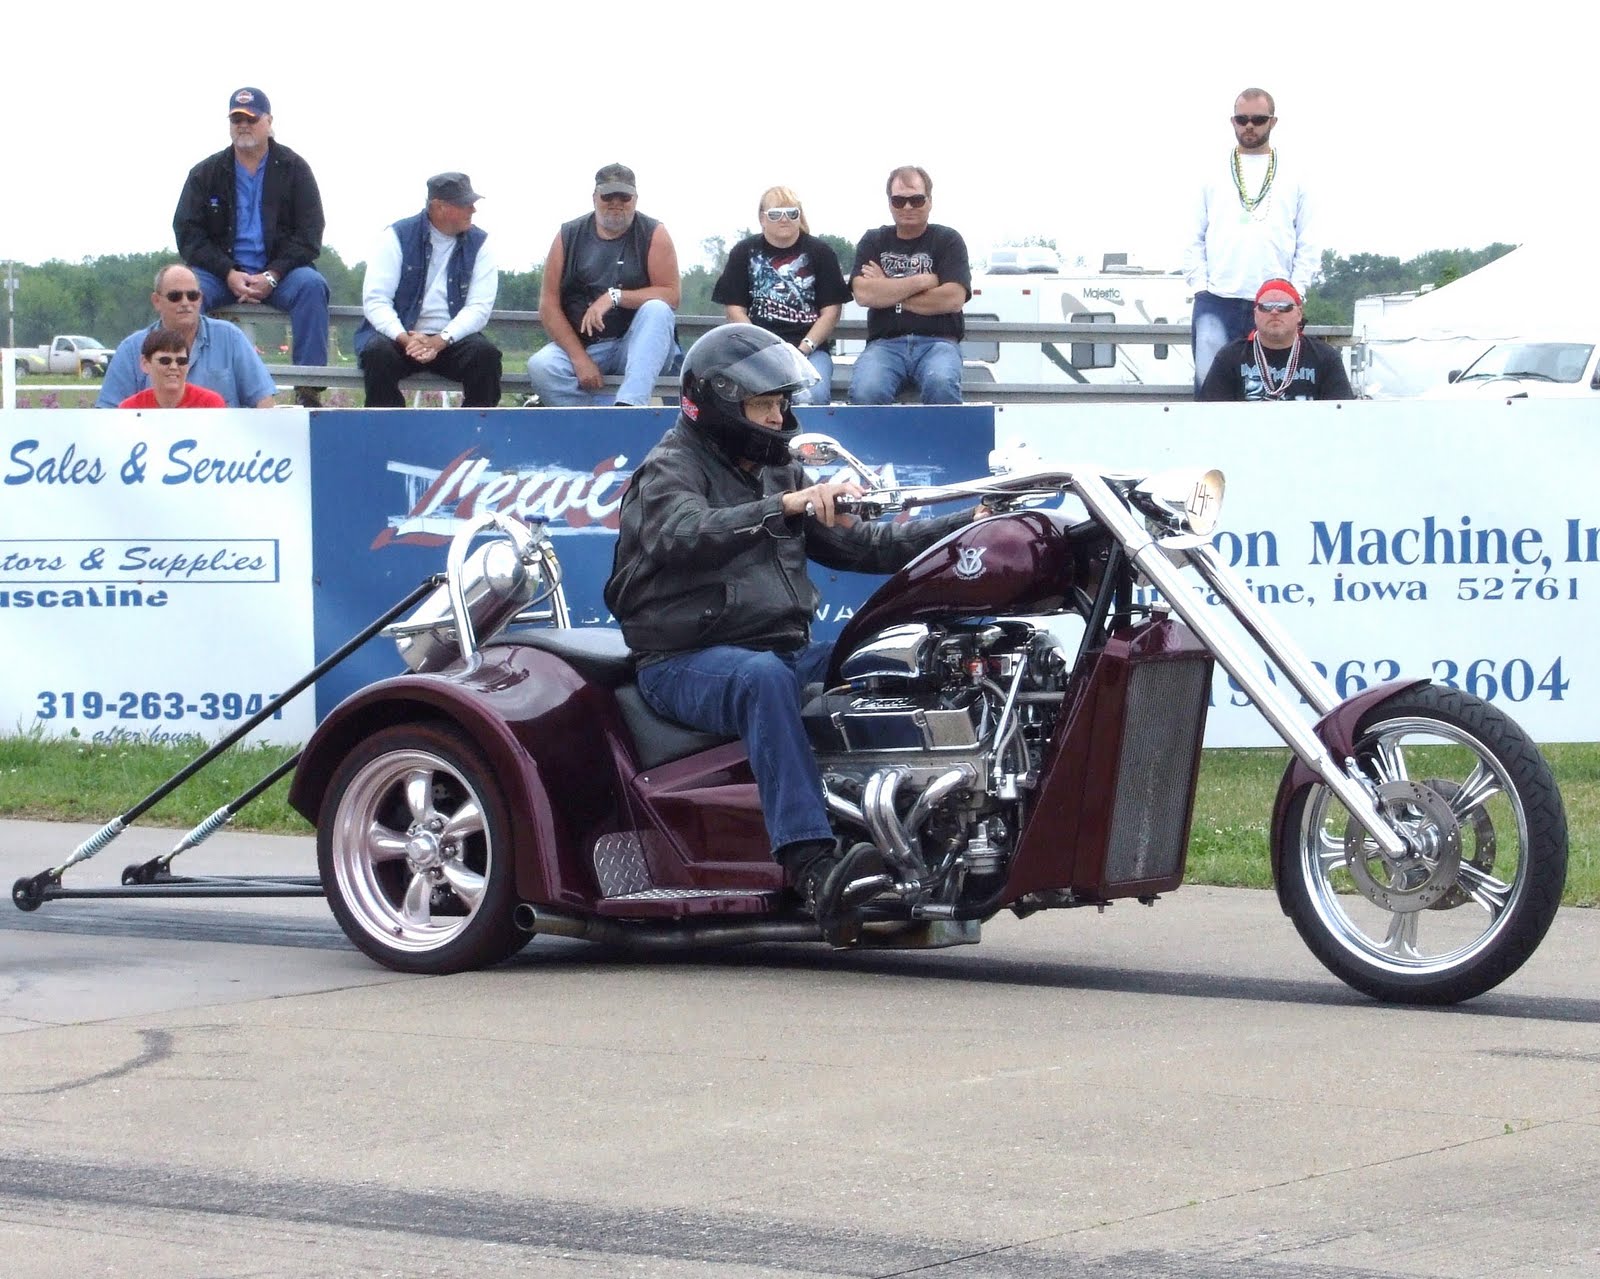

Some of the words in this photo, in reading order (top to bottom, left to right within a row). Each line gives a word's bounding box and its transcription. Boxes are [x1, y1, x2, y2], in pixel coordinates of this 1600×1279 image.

[1083, 287, 1121, 300] Majestic
[4, 439, 107, 485] Sales
[120, 441, 148, 485] &
[162, 439, 293, 485] Service
[1308, 515, 1552, 575] Machine,
[80, 547, 105, 571] &
[118, 546, 267, 578] Supplies
[1457, 577, 1579, 601] 52761
[36, 691, 283, 720] 319-263-3941
